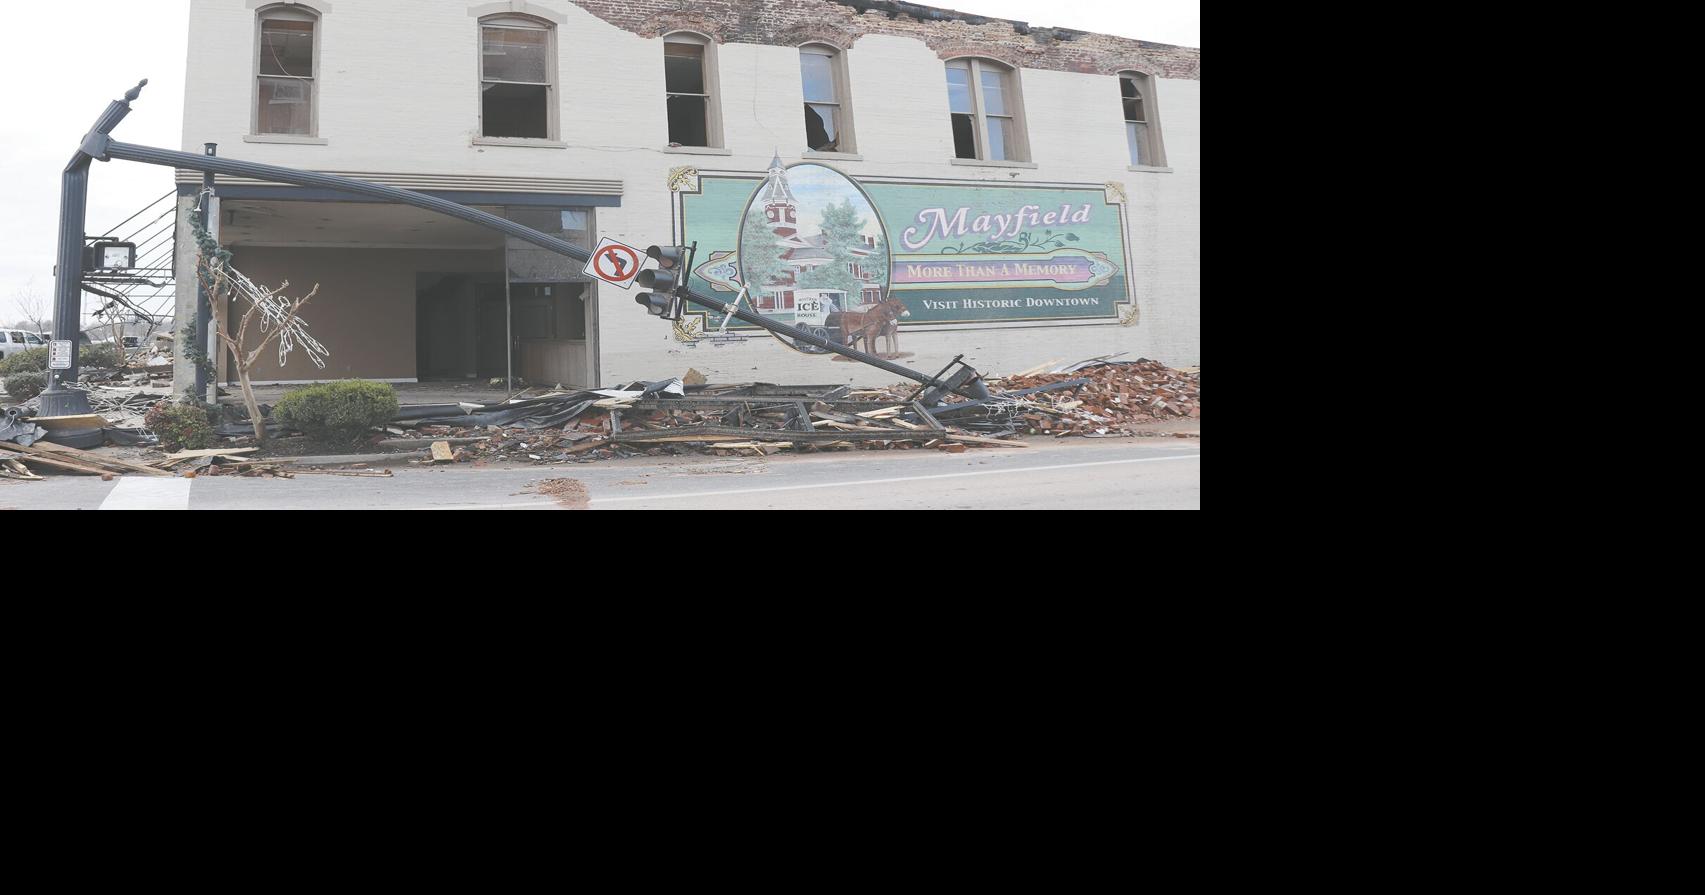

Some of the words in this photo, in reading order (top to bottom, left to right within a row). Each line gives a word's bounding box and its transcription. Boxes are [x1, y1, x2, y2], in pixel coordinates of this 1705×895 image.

[903, 204, 1091, 249] Mayfield
[906, 264, 952, 279] MORE
[956, 263, 999, 278] THAN
[1001, 263, 1010, 276] A
[1014, 262, 1078, 277] MEMORY
[798, 302, 819, 311] ICE
[923, 299, 958, 310] VISIT
[963, 298, 1022, 310] HISTORIC
[1026, 296, 1099, 308] DOWNTOWN
